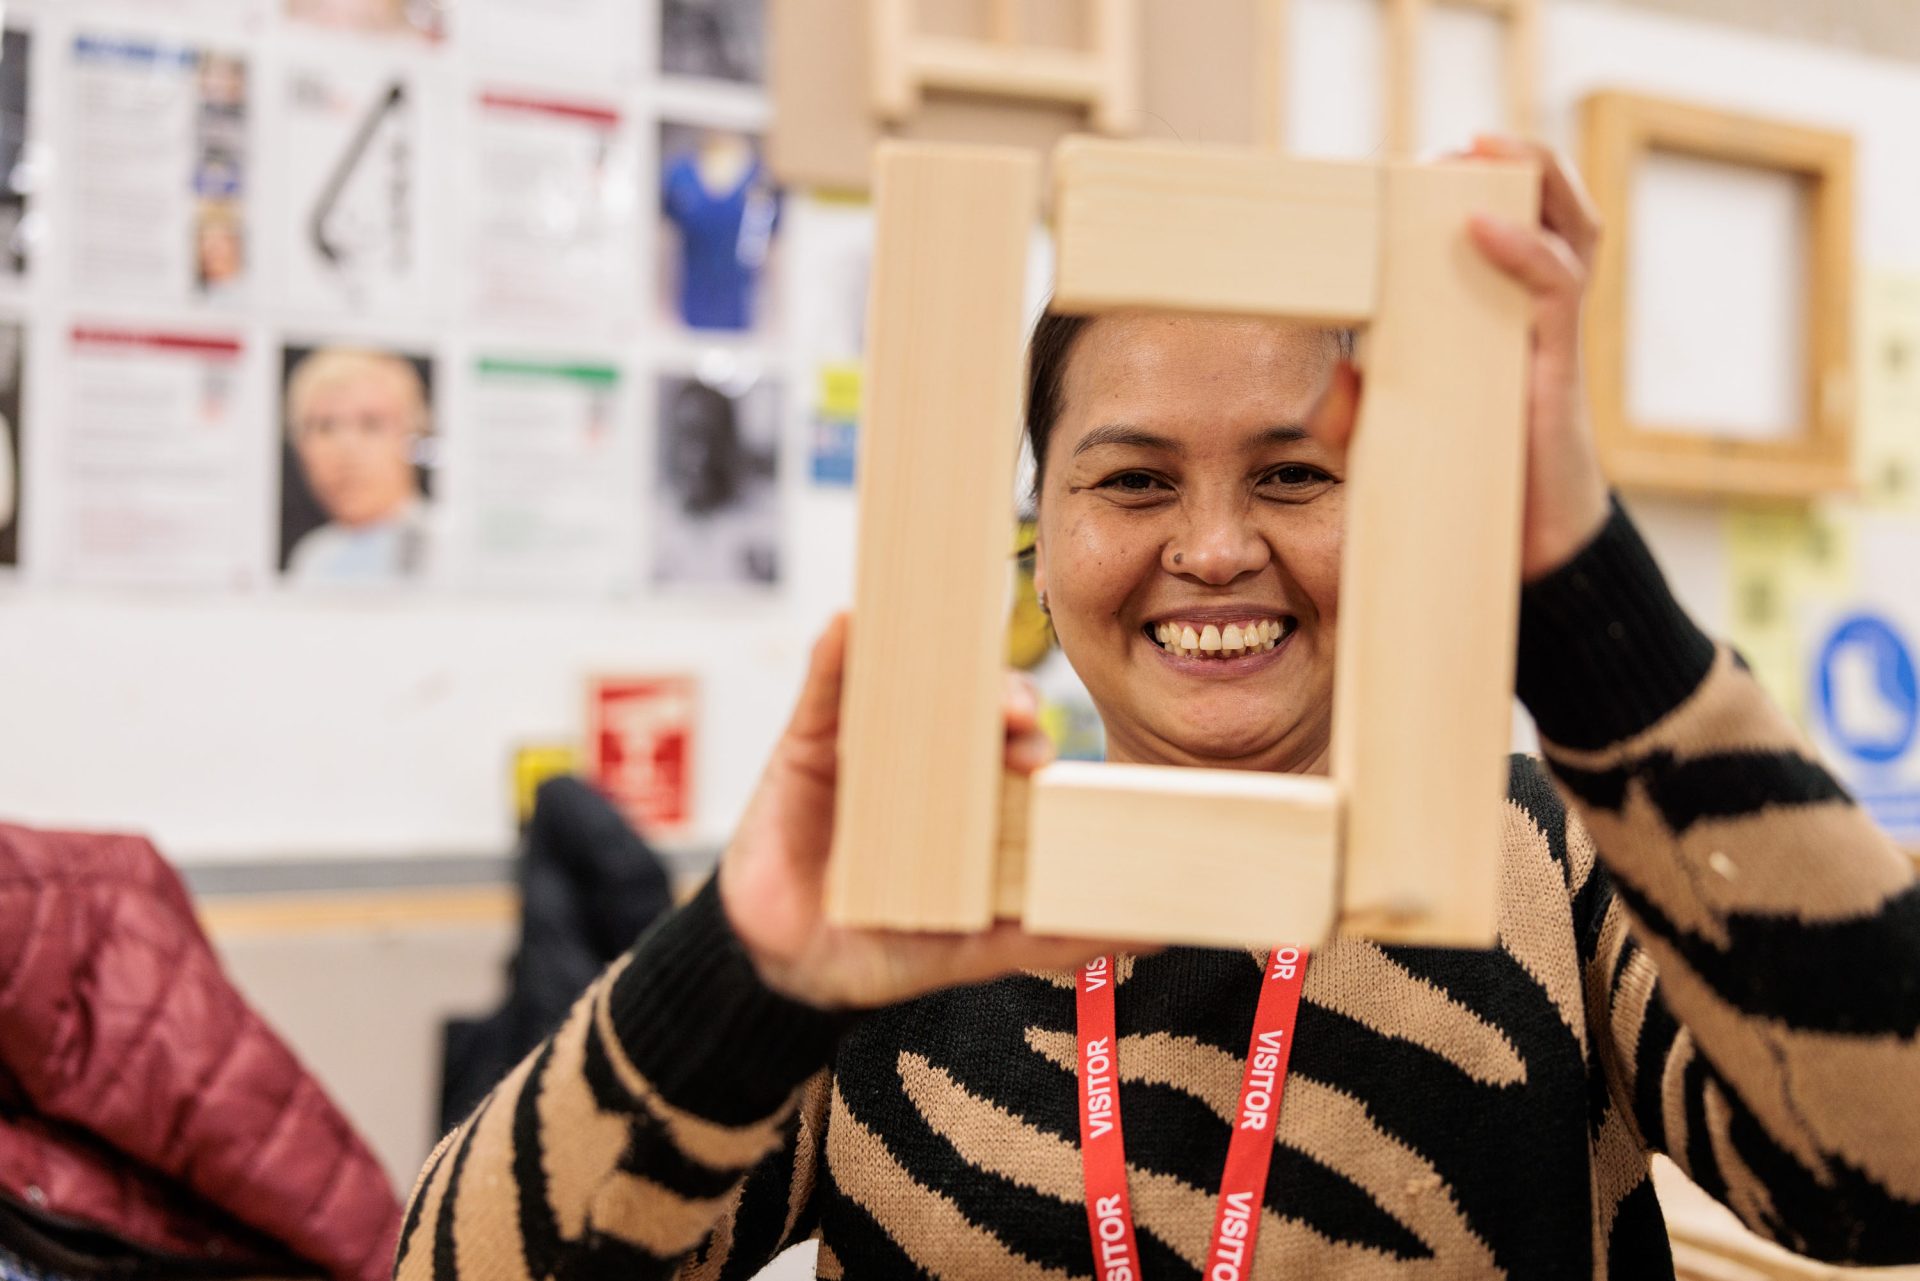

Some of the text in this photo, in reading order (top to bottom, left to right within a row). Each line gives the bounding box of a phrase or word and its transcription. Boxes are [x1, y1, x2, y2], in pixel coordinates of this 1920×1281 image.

[1271, 944, 1300, 980] OR
[1086, 1036, 1114, 1140] VISITOR
[1240, 1029, 1284, 1132] VISITOR
